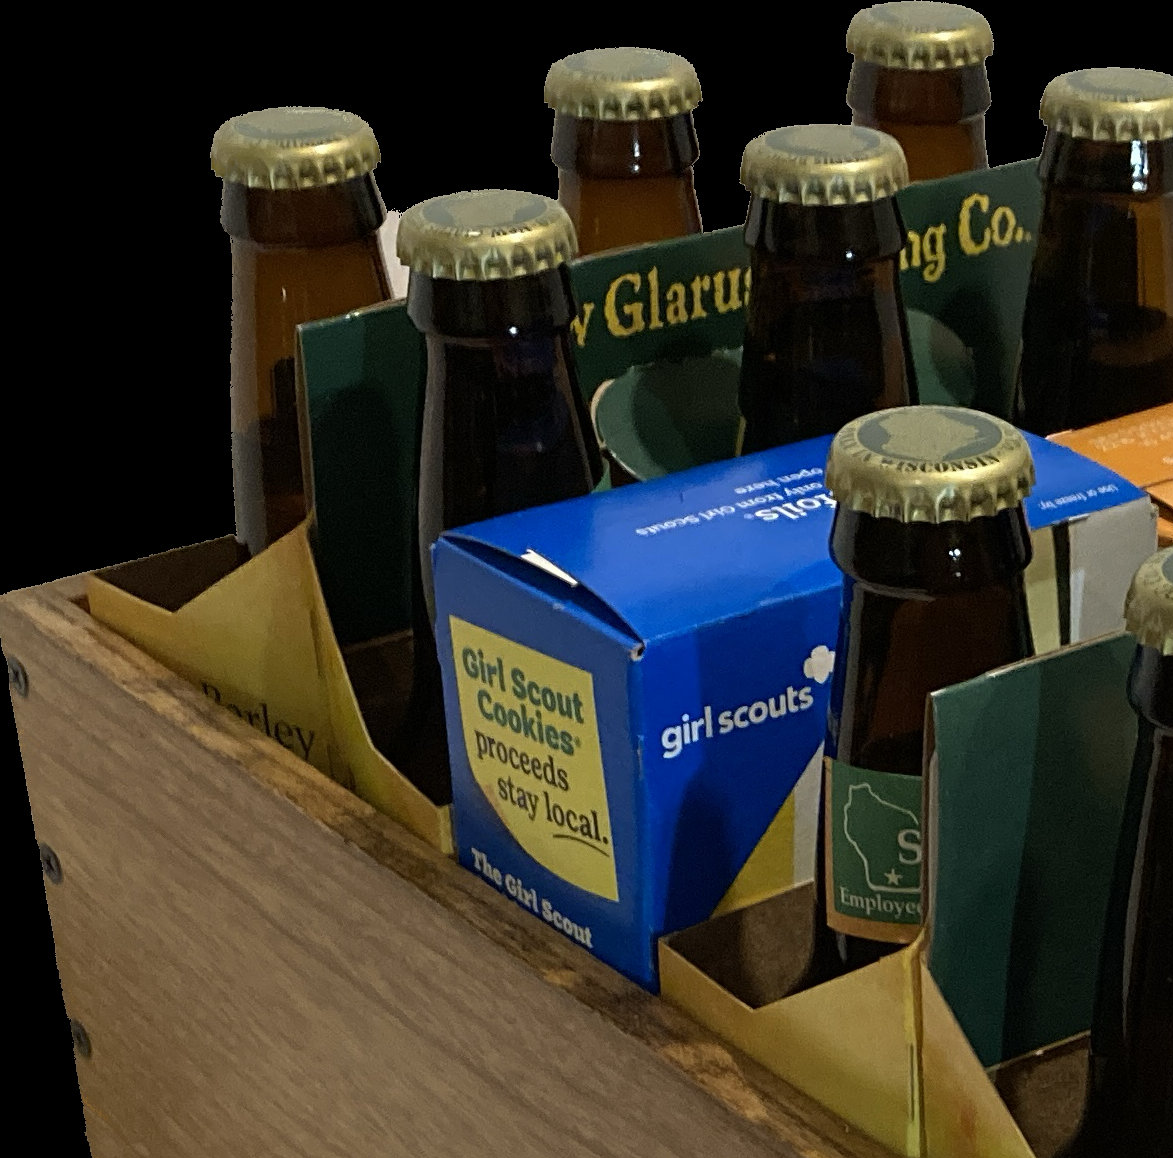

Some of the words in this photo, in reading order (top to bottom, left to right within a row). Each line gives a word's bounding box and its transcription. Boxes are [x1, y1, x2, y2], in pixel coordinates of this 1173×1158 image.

[734, 479, 780, 495] here
[777, 467, 823, 483] open
[735, 492, 784, 509] from
[784, 482, 823, 498] only
[698, 505, 735, 521] Girl
[754, 490, 838, 522] foils
[635, 514, 699, 537] Scouts
[462, 647, 506, 692] Girl
[511, 668, 584, 724] Scout
[661, 705, 713, 759] girl
[718, 686, 814, 735] scouts
[474, 730, 569, 792] proceeds
[497, 776, 538, 821] stay
[544, 791, 609, 845] local.
[471, 847, 502, 886] The
[505, 874, 539, 913] Girl
[542, 898, 594, 949] Scout
